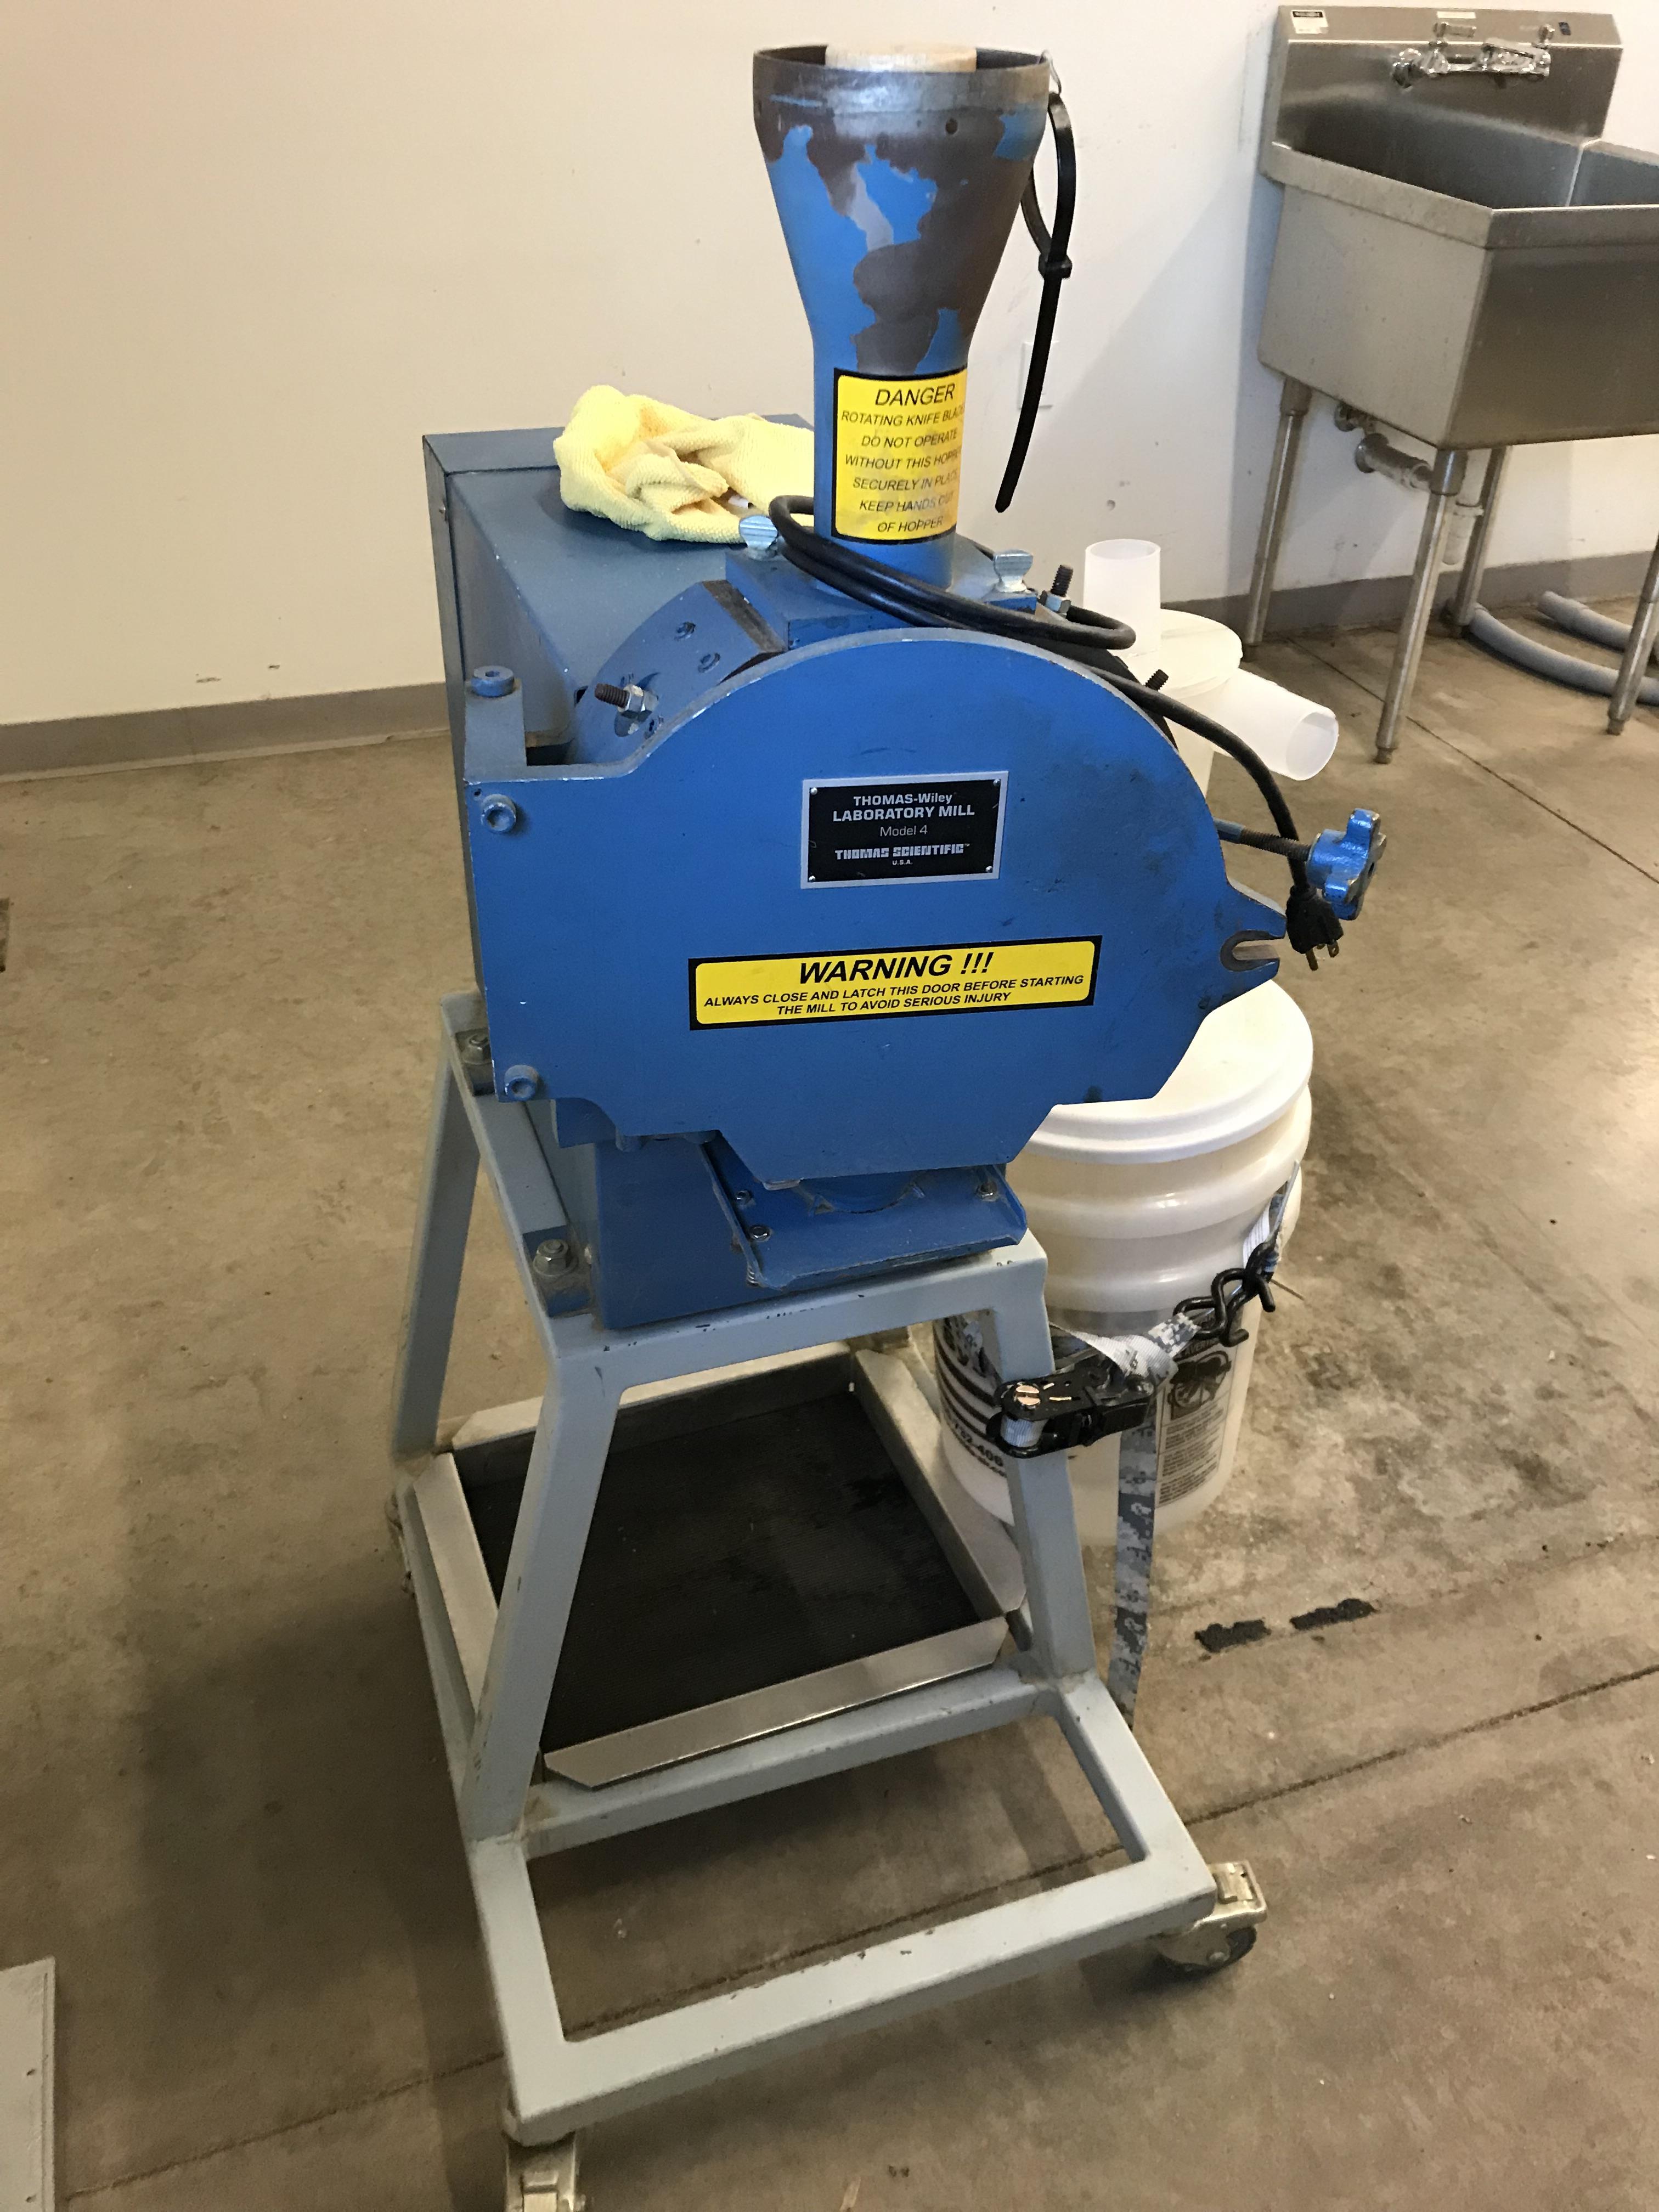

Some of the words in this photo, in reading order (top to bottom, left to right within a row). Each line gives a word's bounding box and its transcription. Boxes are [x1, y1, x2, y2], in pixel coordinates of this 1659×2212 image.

[875, 383, 955, 406] DANGER
[842, 410, 902, 426] ROTATING
[906, 412, 940, 426] KNIFE
[862, 436, 880, 447] DO
[884, 436, 911, 448] NOT
[915, 428, 957, 447] OPERATE
[845, 455, 902, 470] WITHOUT
[906, 456, 931, 469] THIS
[853, 477, 919, 490] SECURELY
[921, 478, 932, 489] IN
[860, 500, 894, 511] KEEP
[896, 498, 935, 511] HANDS
[938, 492, 954, 505] OUT
[878, 522, 894, 532] OF
[899, 516, 943, 532] HOPPER
[854, 793, 952, 806] THOMAS-Wiley
[833, 807, 934, 822] LABORATORY
[939, 805, 975, 817] MILL
[880, 826, 916, 837] Model
[919, 825, 928, 834] 4
[835, 848, 889, 860] THOMAS
[800, 955, 952, 983] WARNING
[960, 952, 994, 974] !!!
[704, 995, 759, 1007] ALWAYS
[763, 992, 808, 1003] CLOSE
[810, 990, 839, 1000] AND
[843, 988, 885, 998] LATCH
[890, 986, 918, 996] THIS
[922, 983, 960, 994] DOOR
[964, 979, 1017, 991] BEFORE
[1020, 975, 1084, 988] STARTING
[777, 1006, 802, 1015] THE
[806, 1004, 836, 1013] MILL
[841, 1002, 857, 1011] TO
[860, 999, 900, 1009] AVOID
[904, 995, 961, 1007] SERIOUS
[964, 992, 1011, 1003] INJURY
